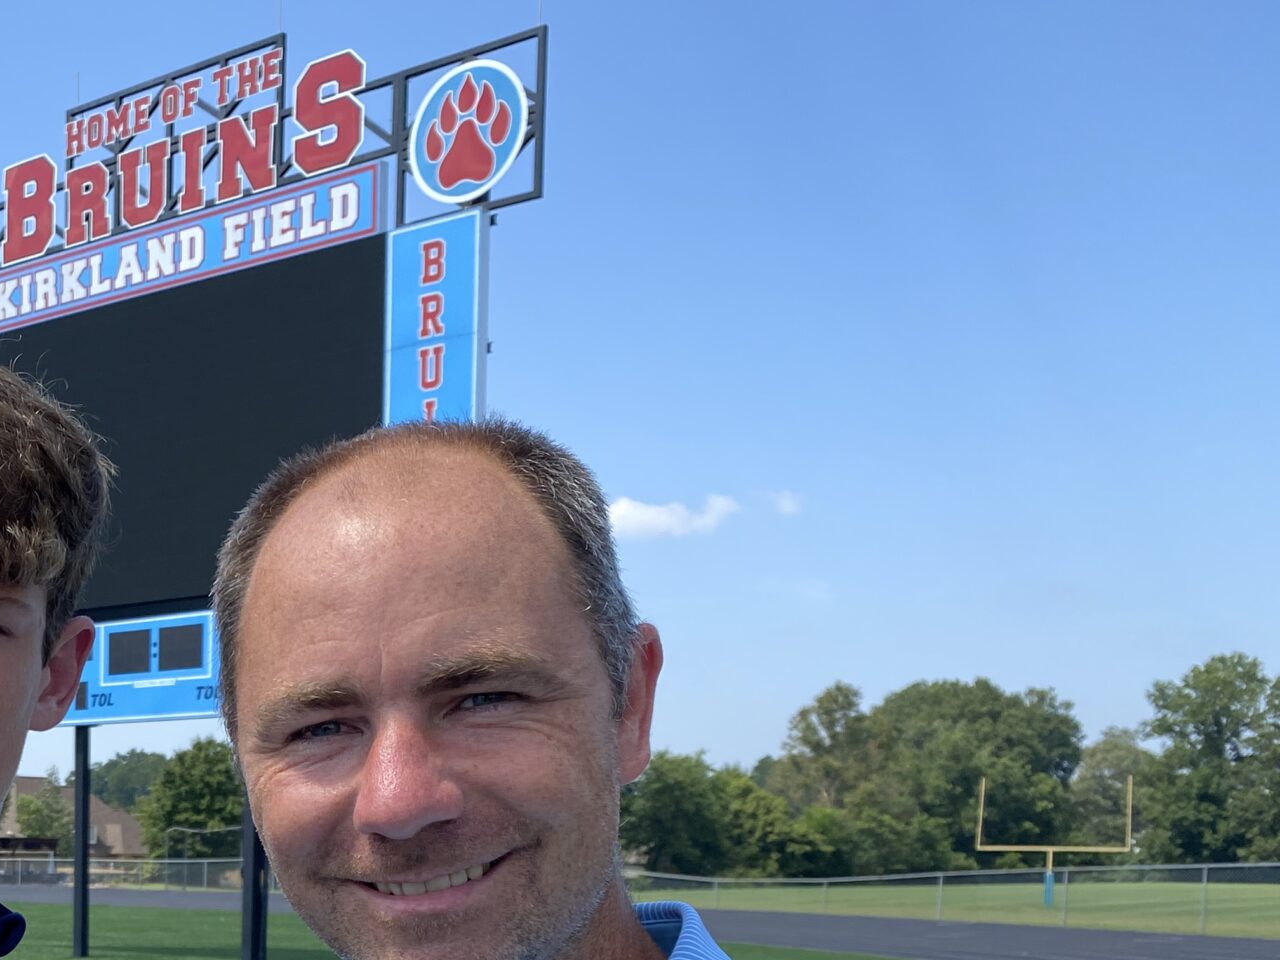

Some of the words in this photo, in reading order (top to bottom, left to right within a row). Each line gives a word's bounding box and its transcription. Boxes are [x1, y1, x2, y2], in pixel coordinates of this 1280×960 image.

[65, 95, 152, 158] HOME
[161, 77, 202, 124] OF
[212, 47, 283, 106] THE
[2, 49, 366, 266] BRUINS
[222, 181, 361, 260] FIELD
[91, 692, 114, 707] TOL
